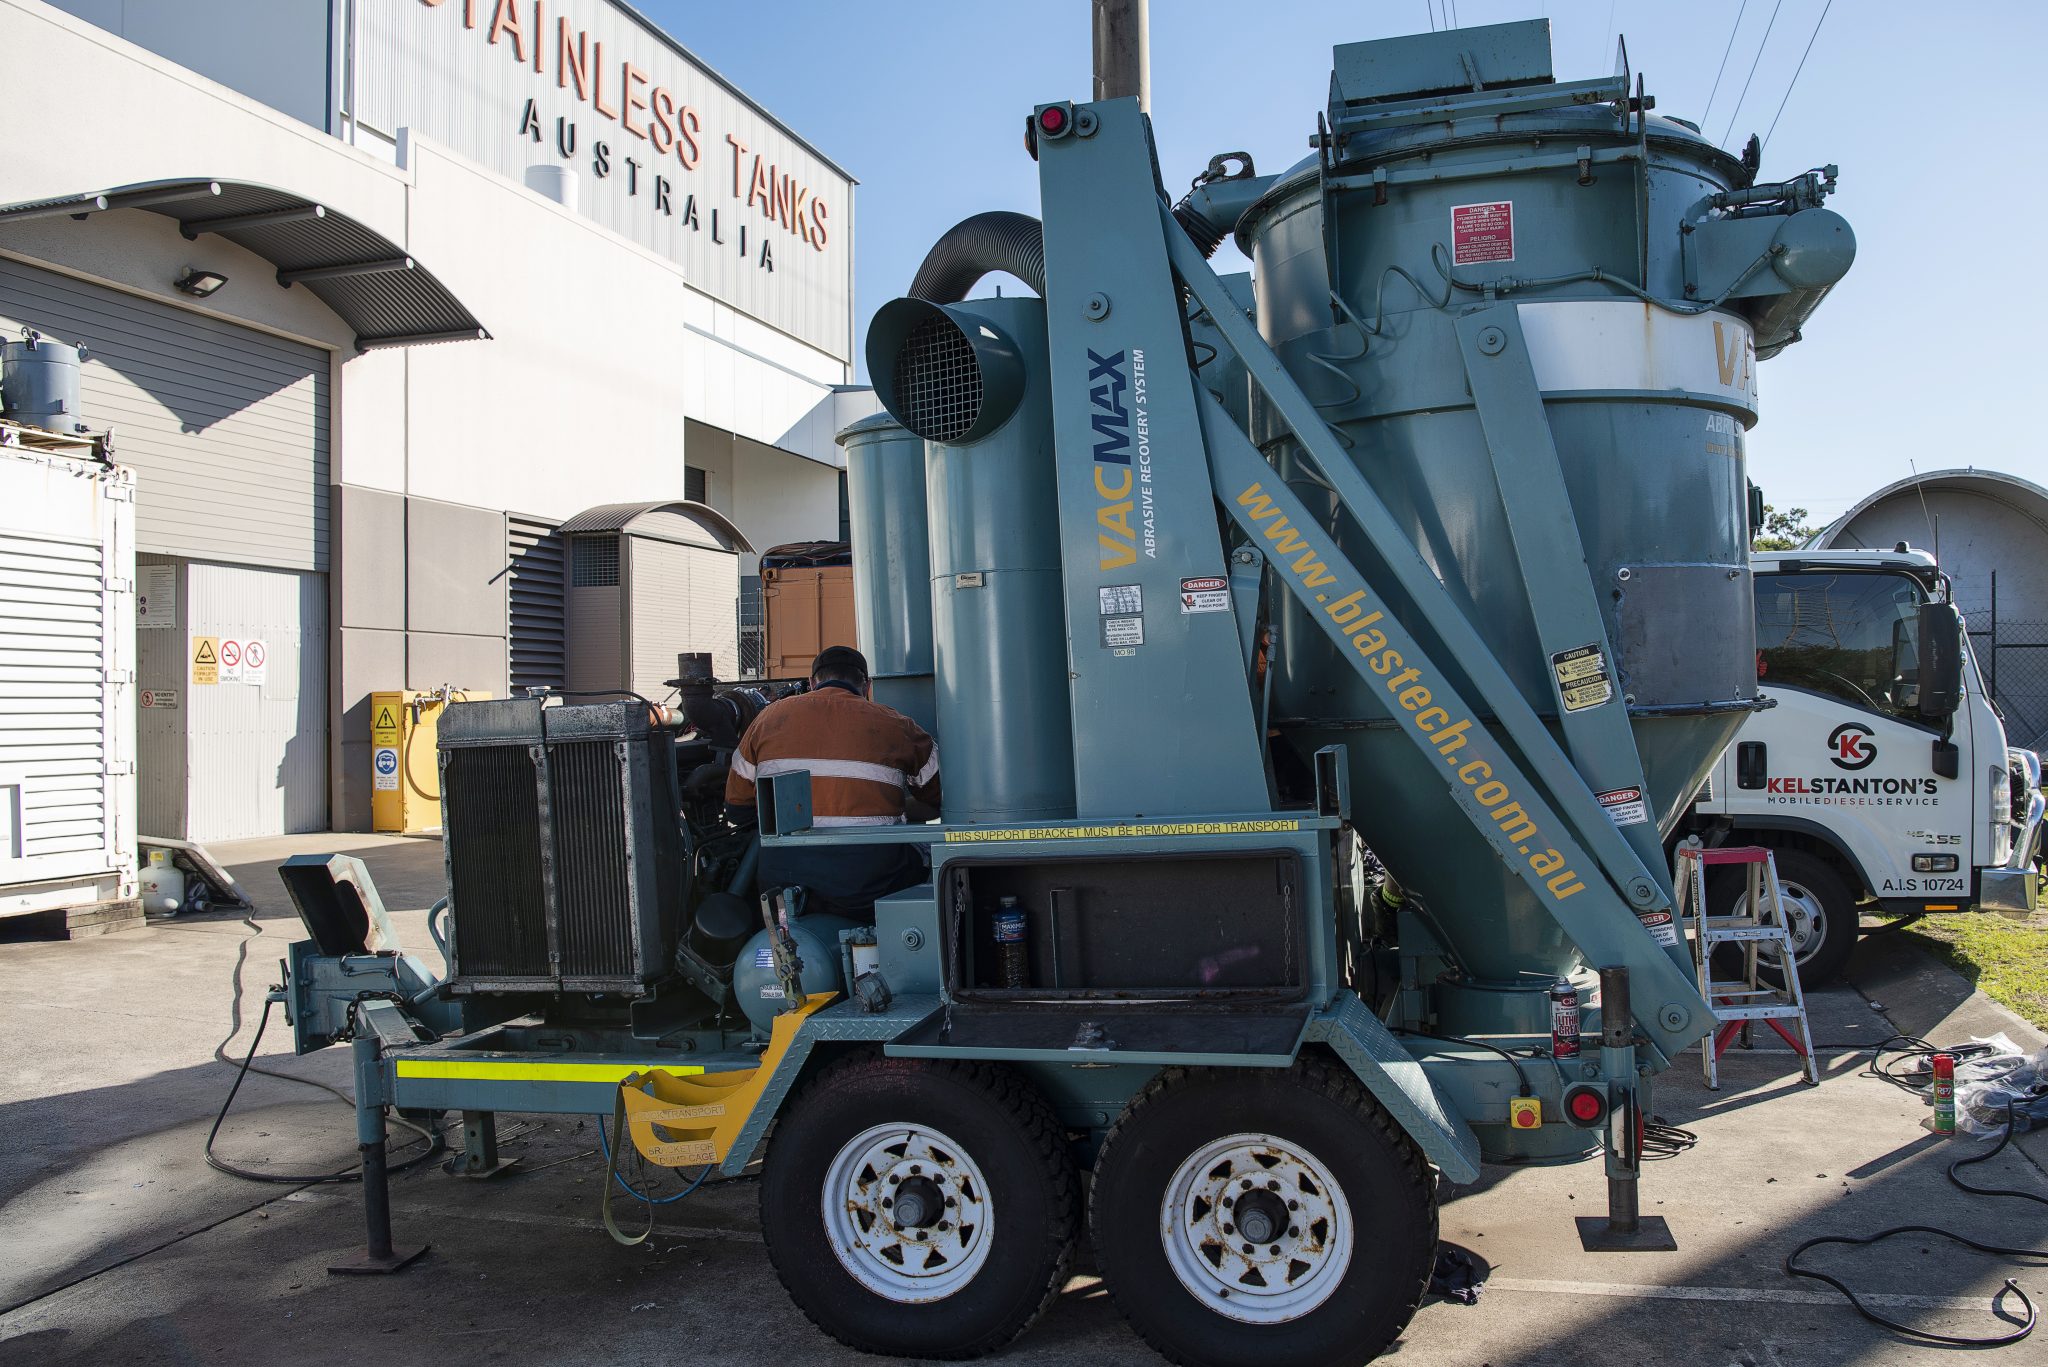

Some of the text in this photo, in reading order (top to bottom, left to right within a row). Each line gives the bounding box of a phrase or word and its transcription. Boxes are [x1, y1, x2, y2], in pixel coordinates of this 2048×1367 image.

[521, 98, 775, 273] AUSTRALIA
[726, 133, 829, 252] TANKS
[1088, 347, 1137, 572] VACMAX
[1133, 349, 1156, 558] ABRASIVE RECOVERY SYSTEM
[1187, 581, 1221, 589] DANGER
[1564, 649, 1589, 660] CAUTION
[1565, 675, 1603, 689] PRECAUCION
[1236, 482, 1586, 901] www.blastech.com.au
[1599, 791, 1634, 804] DANGER
[948, 820, 1297, 841] THIS SUPPORT BRACKET MUST BE REMOVED FOR TRANSPORT
[1925, 835, 1962, 845] 155
[1921, 878, 1964, 891] 10724
[1640, 914, 1665, 924] NGER
[1937, 1086, 1952, 1096] RP7
[665, 1105, 724, 1118] TRANSPORT
[648, 1142, 714, 1155] BRACKET FOR
[688, 1152, 716, 1162] CAGE
